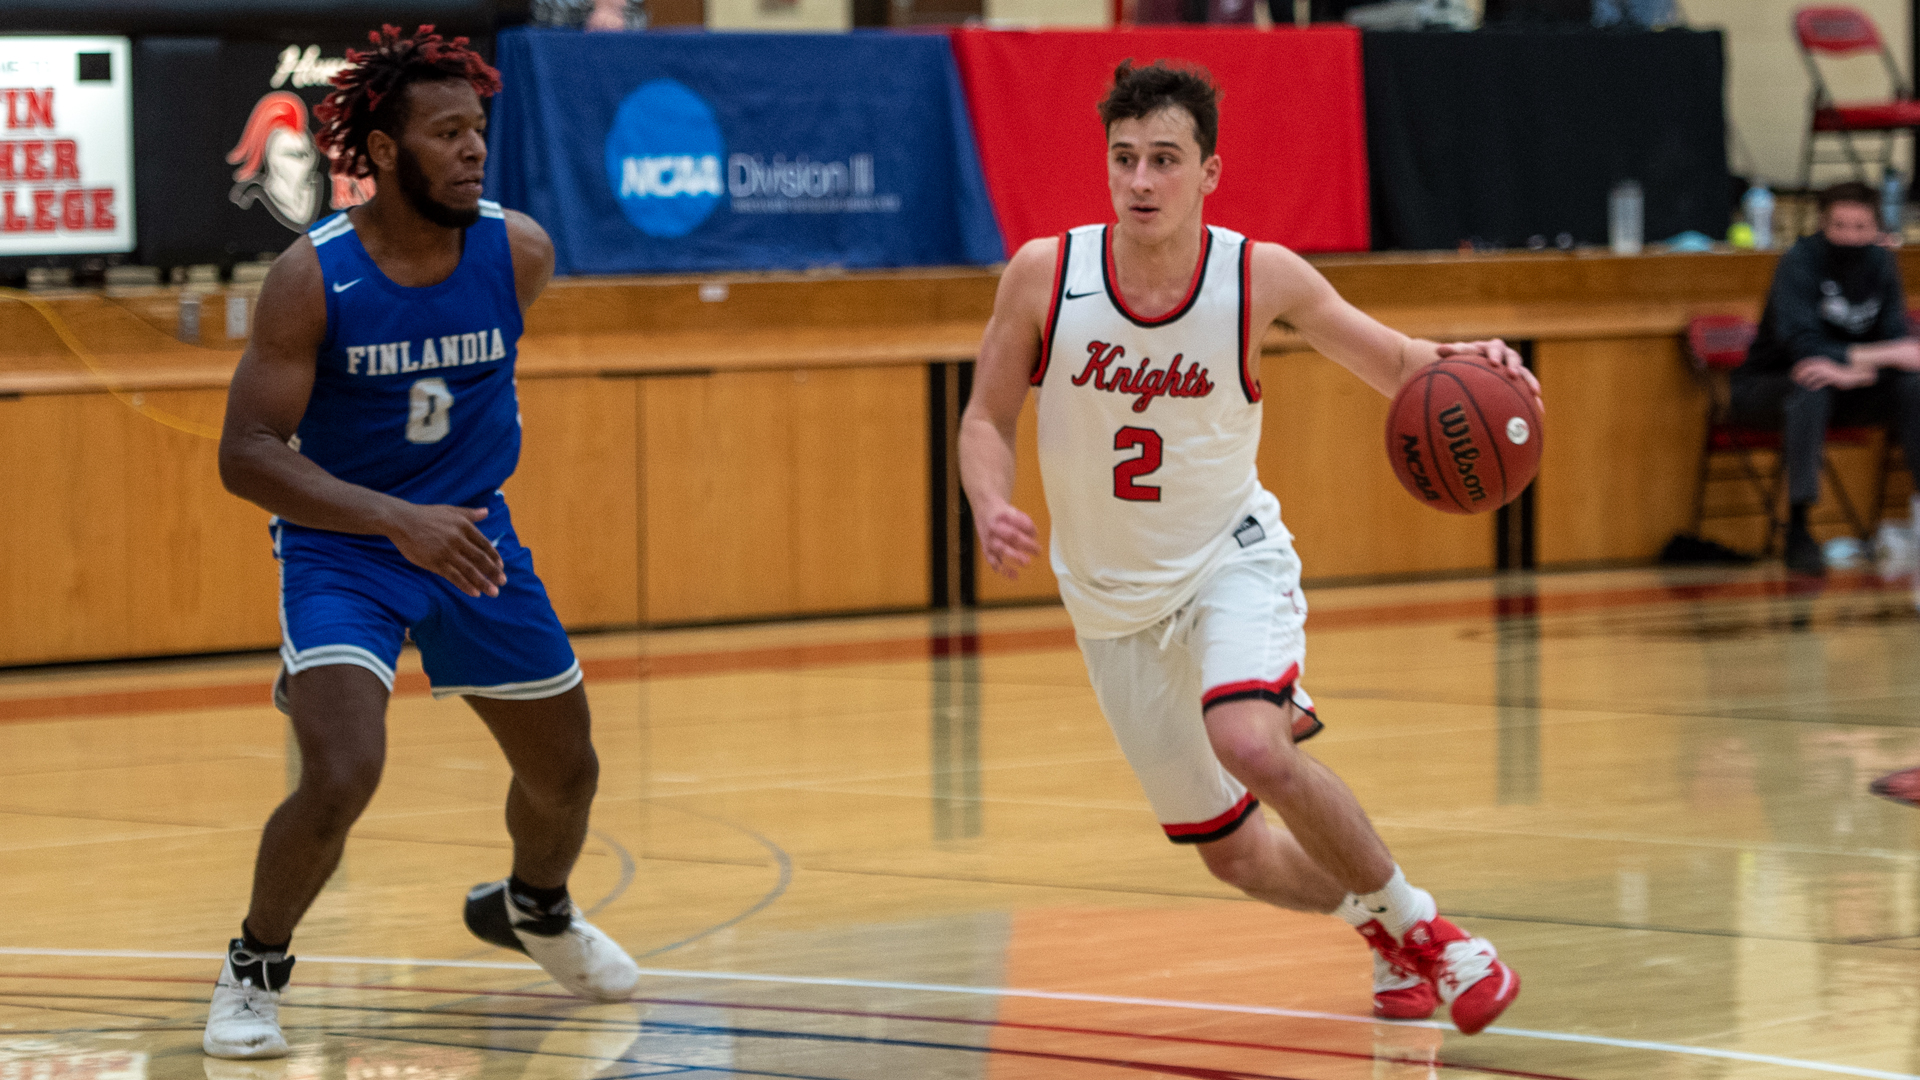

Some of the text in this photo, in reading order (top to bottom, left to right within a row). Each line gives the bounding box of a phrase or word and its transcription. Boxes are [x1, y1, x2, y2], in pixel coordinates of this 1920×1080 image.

[0, 87, 55, 129] IN
[620, 155, 723, 197] NCAA
[728, 152, 849, 197] Division
[0, 188, 116, 232] LEGE
[346, 328, 506, 376] FINLANDIA
[1071, 340, 1214, 413] Knights
[405, 376, 454, 444] 0
[1113, 425, 1163, 502] 2
[1401, 433, 1440, 501] NCAA
[1438, 403, 1487, 502] Wilson
